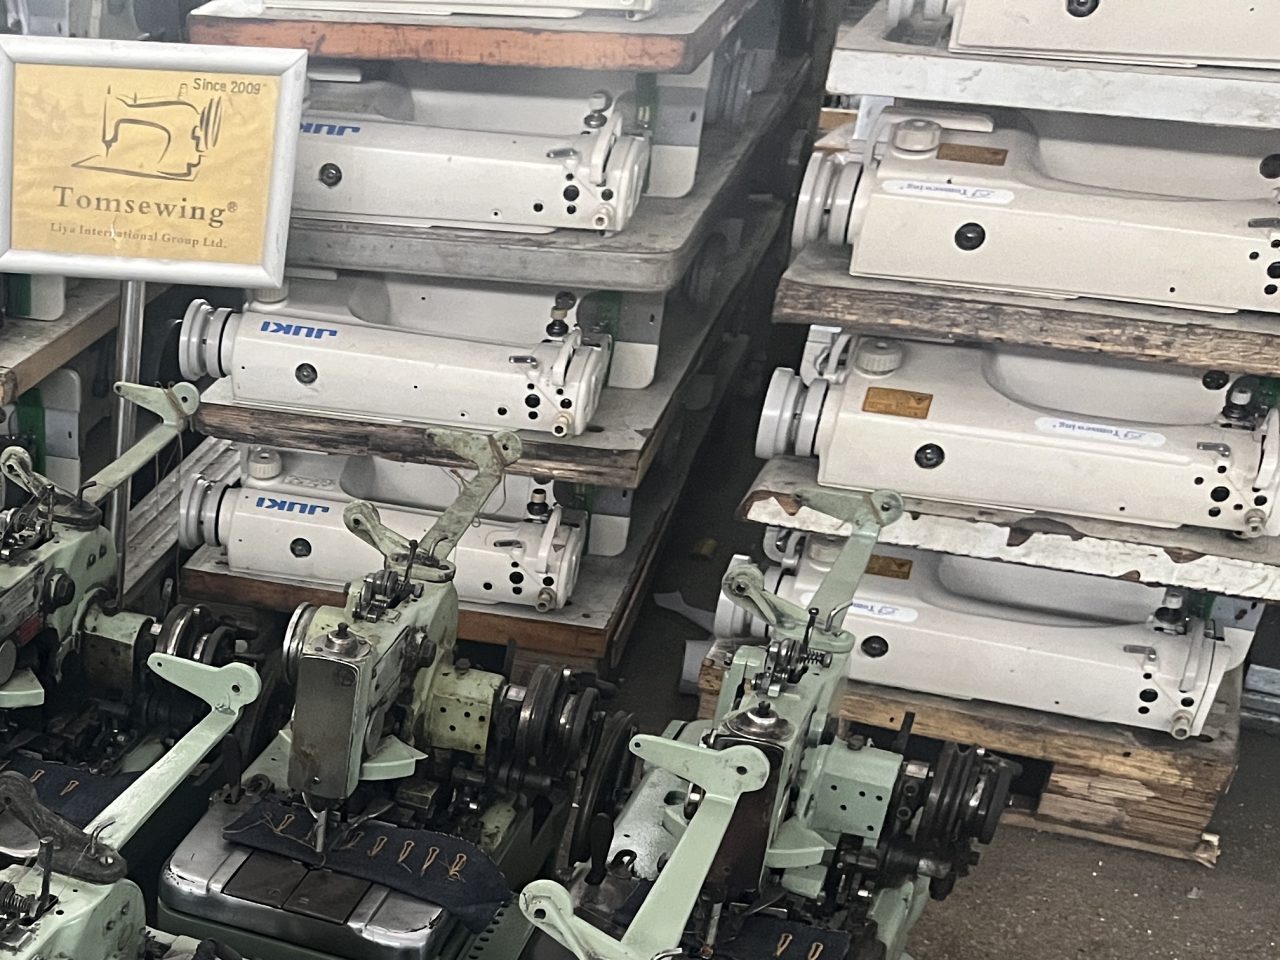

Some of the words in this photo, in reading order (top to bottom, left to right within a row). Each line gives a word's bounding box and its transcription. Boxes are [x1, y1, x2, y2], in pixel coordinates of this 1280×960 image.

[192, 77, 227, 92] Since
[230, 80, 261, 95] 2009
[299, 122, 361, 136] JUK
[161, 232, 200, 248] Group
[203, 236, 228, 249] Ltd.
[260, 320, 338, 339] JUKI
[255, 496, 330, 516] JUKI
